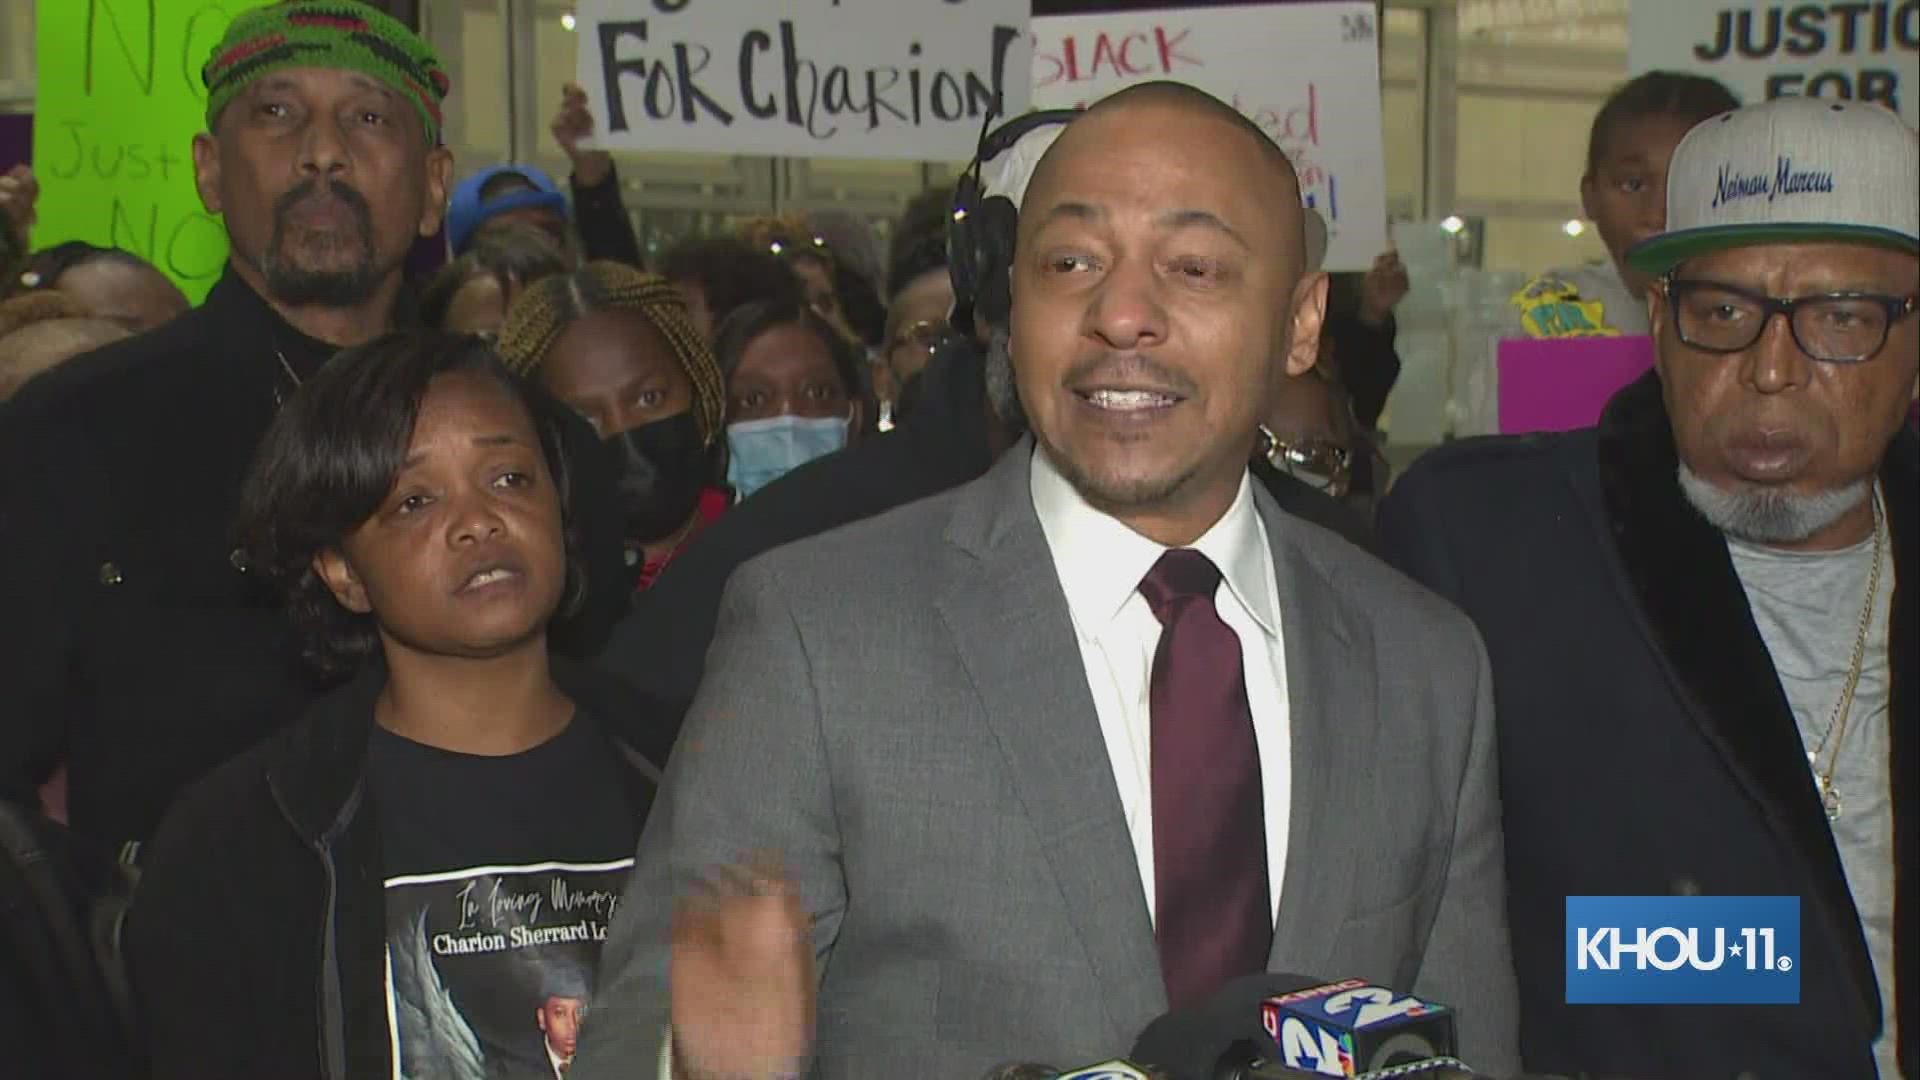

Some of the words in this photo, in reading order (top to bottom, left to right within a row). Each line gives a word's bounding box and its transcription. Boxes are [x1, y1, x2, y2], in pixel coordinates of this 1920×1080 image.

[1712, 160, 1770, 208] Neiman
[1768, 154, 1834, 202] Marcus
[433, 931, 507, 955] Charion
[510, 919, 588, 948] Sherrard
